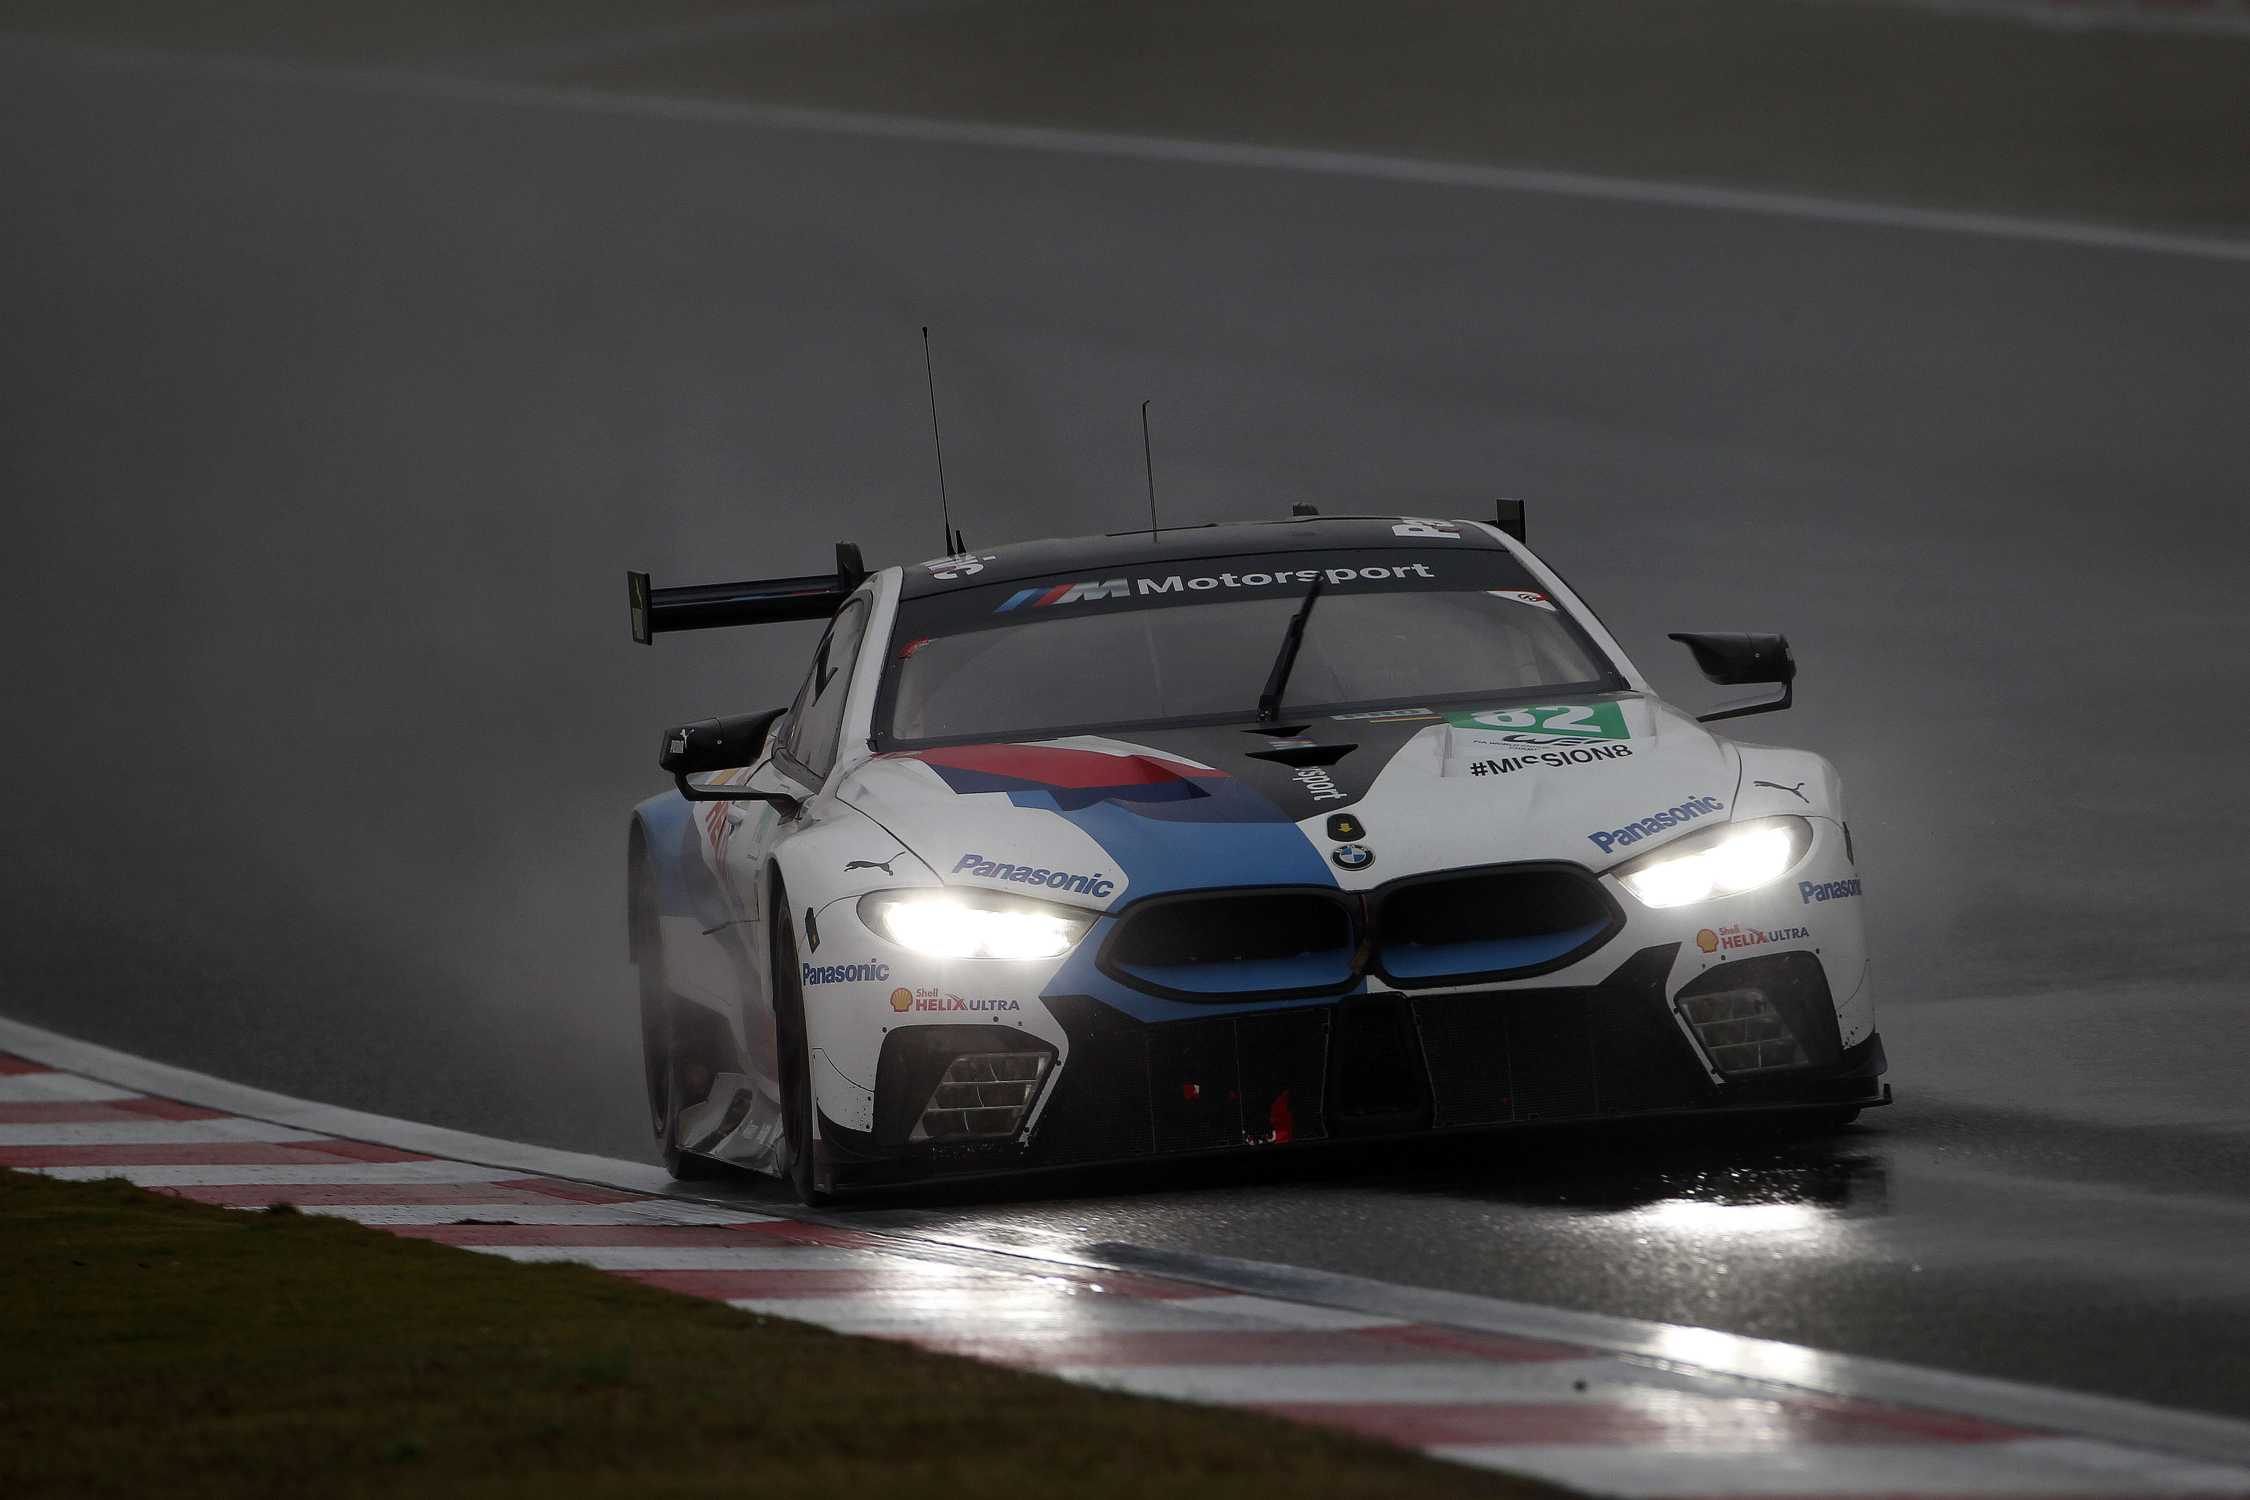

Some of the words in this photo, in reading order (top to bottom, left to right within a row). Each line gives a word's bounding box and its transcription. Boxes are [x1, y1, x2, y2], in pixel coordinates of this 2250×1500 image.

[1137, 563, 1435, 596] Motorsport
[1587, 795, 1725, 854] Panasonic
[951, 853, 1114, 898] Panasonic
[1720, 930, 1769, 950] HELIX
[1769, 927, 1810, 942] ULTRA
[802, 958, 890, 986] Panasonic
[915, 995, 968, 1012] HELIX
[968, 999, 1021, 1011] ULTRA
[916, 988, 939, 998] Shell
